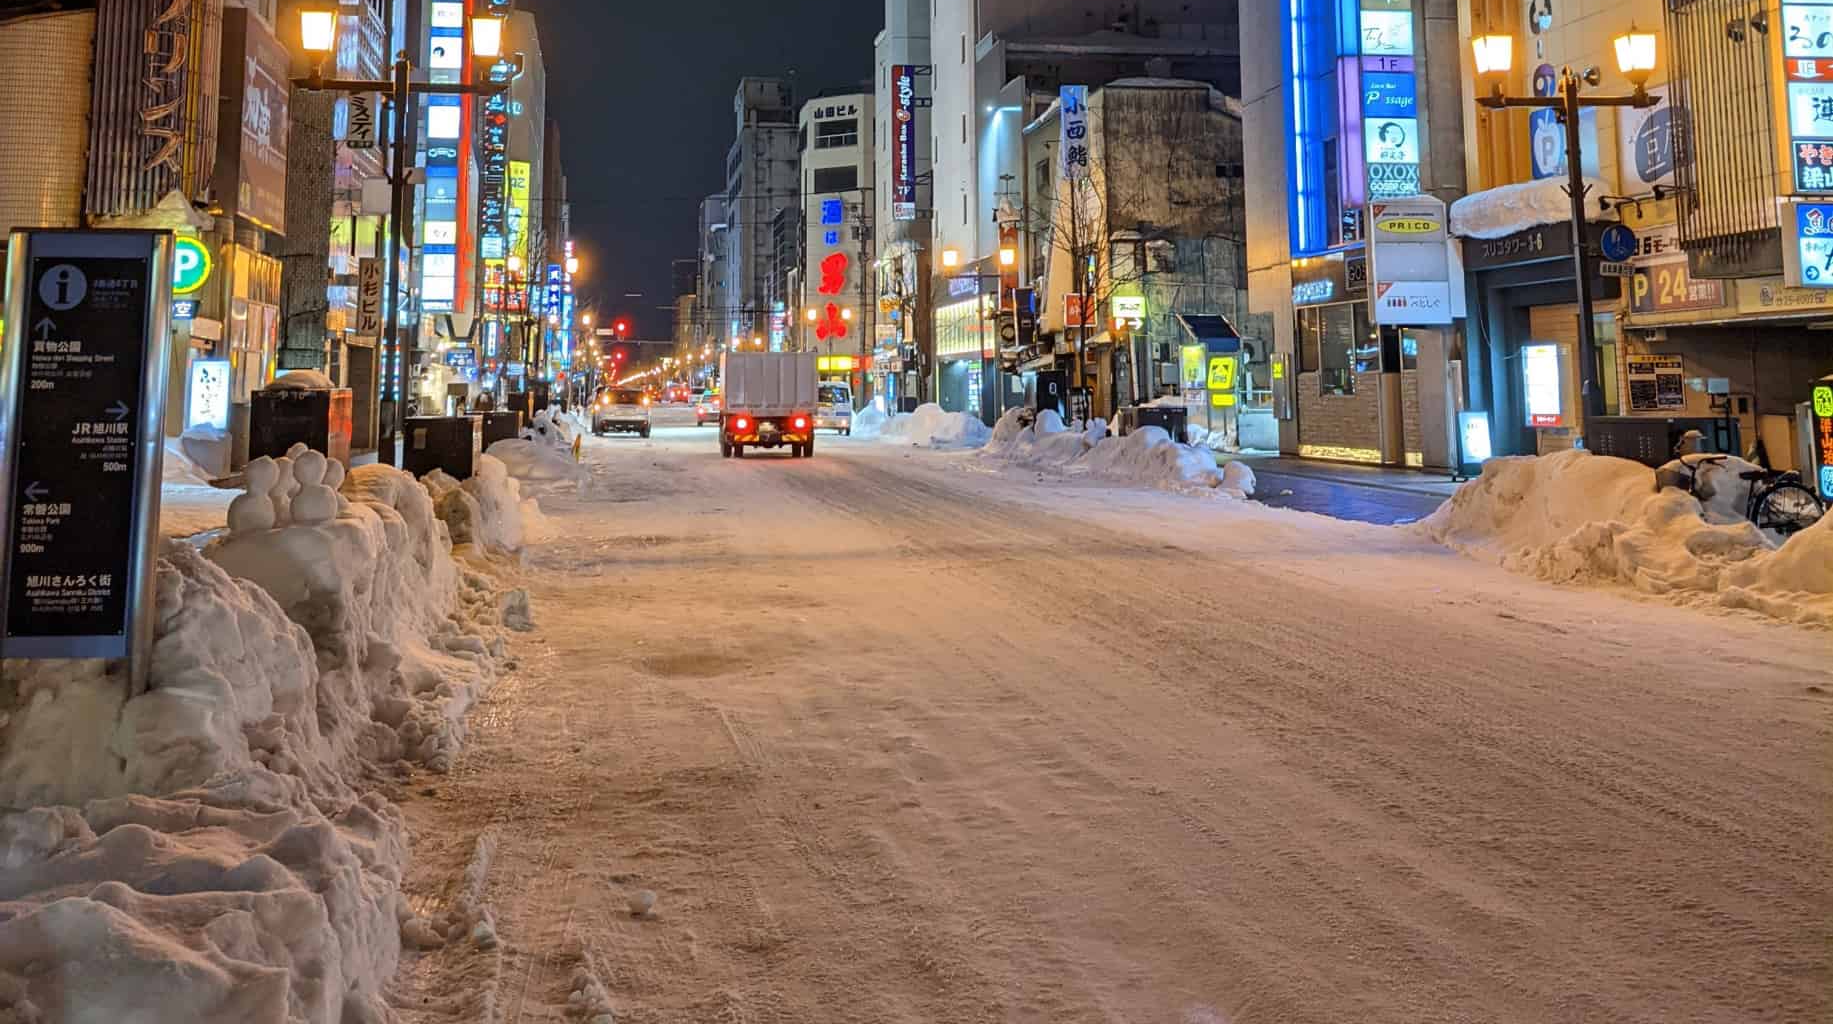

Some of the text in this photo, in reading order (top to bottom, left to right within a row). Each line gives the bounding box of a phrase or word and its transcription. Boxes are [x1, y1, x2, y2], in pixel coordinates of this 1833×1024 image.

[1378, 56, 1398, 70] 1F
[351, 95, 372, 140] ミスティ
[814, 104, 858, 119] 山田ビル
[1388, 221, 1431, 231] PRICO
[173, 248, 199, 283] P
[1633, 272, 1649, 308] P
[1658, 266, 1688, 306] 24
[362, 264, 381, 331] 小杉ビル
[102, 461, 127, 472] 500m
[19, 543, 45, 553] 900m
[26, 574, 112, 588] 旭川さんろく街
